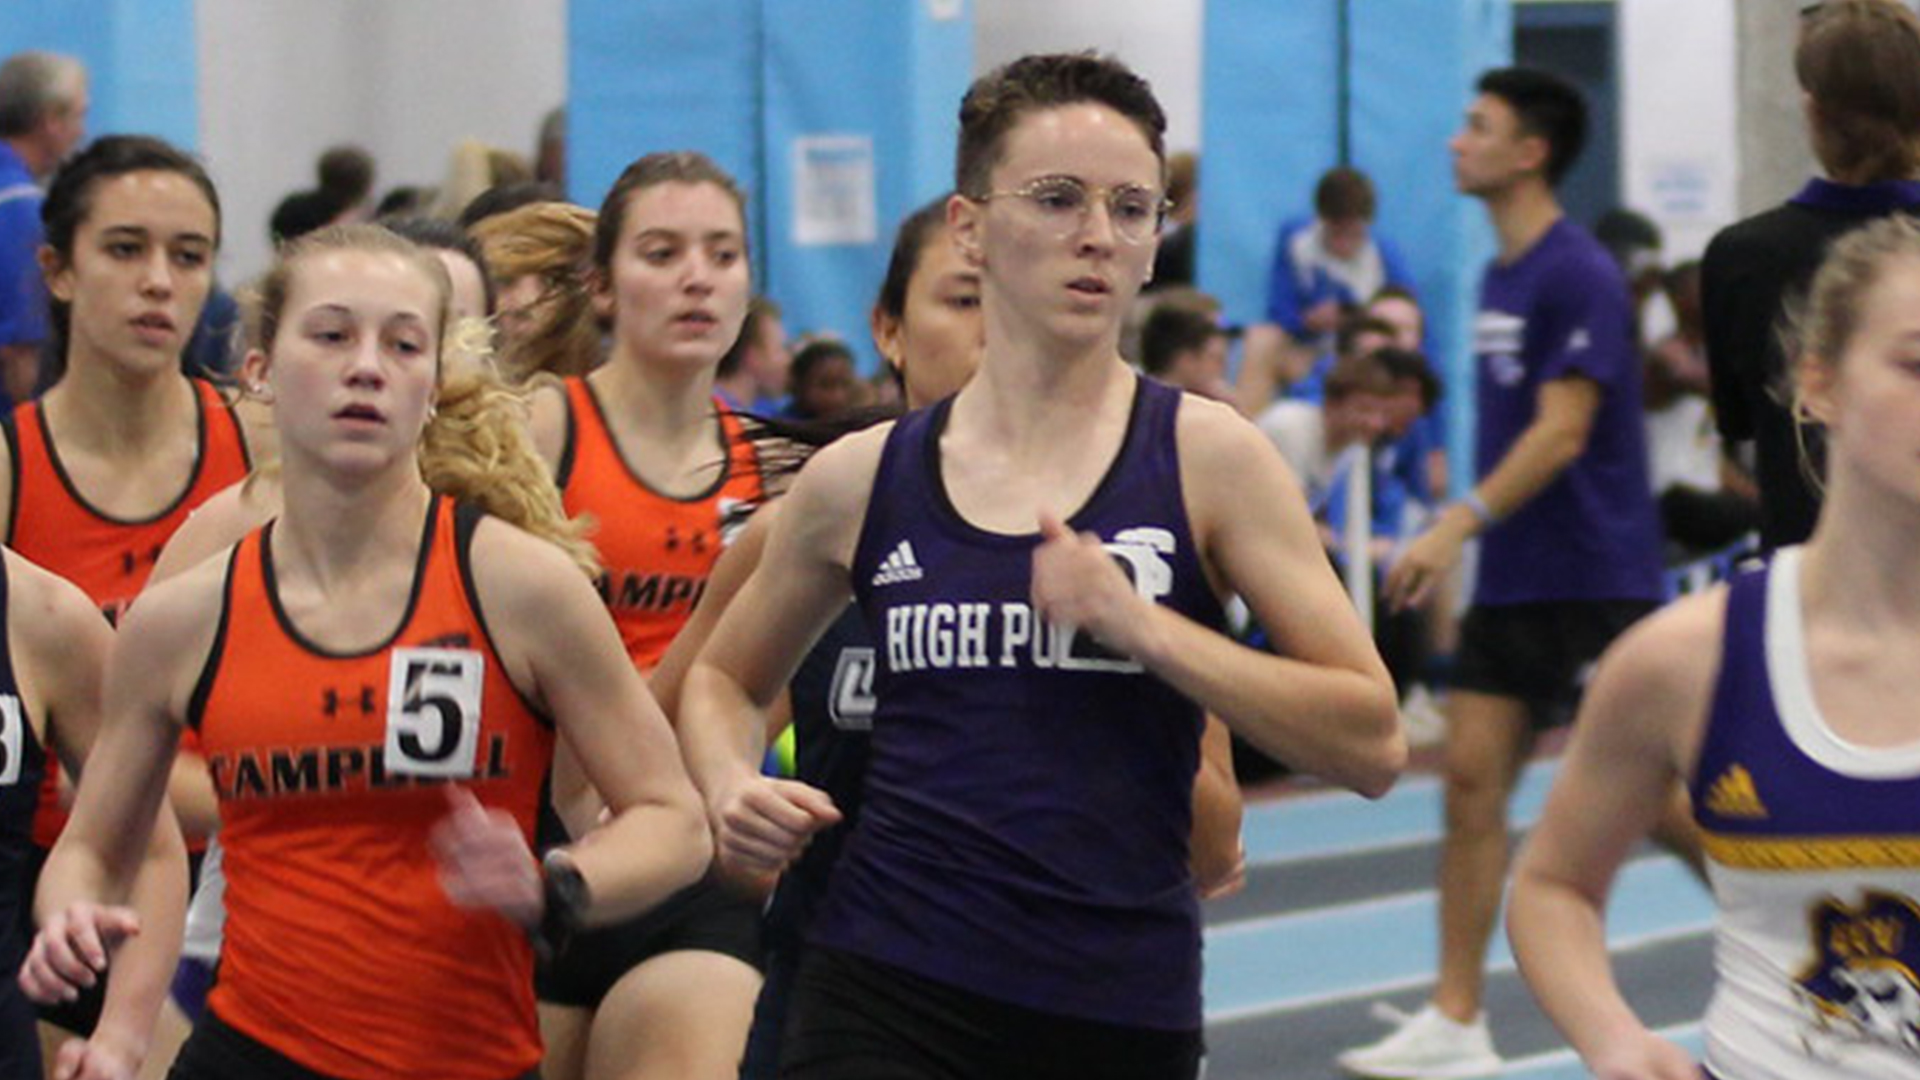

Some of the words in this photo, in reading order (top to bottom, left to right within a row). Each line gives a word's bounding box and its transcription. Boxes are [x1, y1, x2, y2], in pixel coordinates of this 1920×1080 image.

[592, 570, 708, 612] AMP
[887, 603, 991, 672] HIGH
[397, 661, 464, 763] 5
[211, 733, 509, 801] CAMPL
